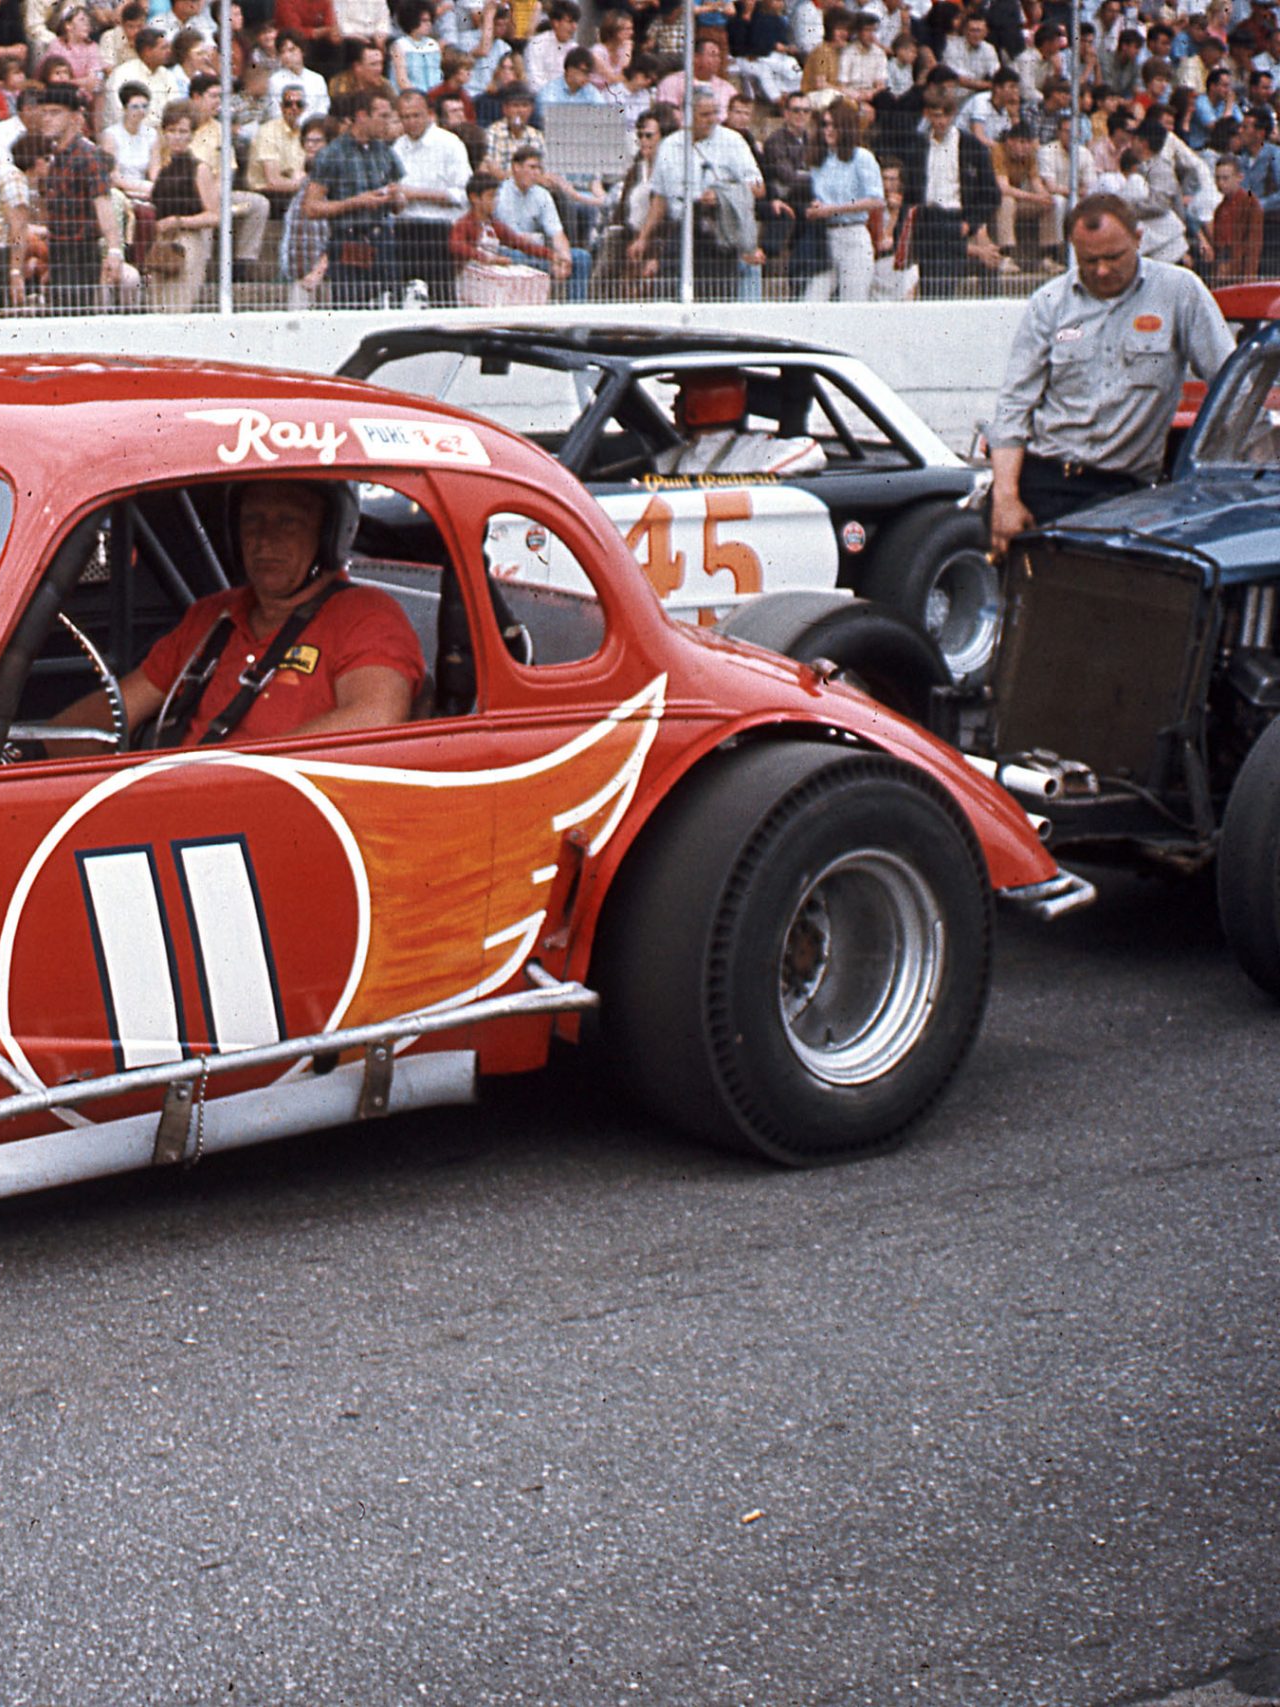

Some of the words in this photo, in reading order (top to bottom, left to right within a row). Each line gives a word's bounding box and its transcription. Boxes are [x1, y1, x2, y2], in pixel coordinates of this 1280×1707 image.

[184, 408, 347, 464] Ray
[625, 491, 763, 626] 45
[75, 834, 287, 1071] 11
